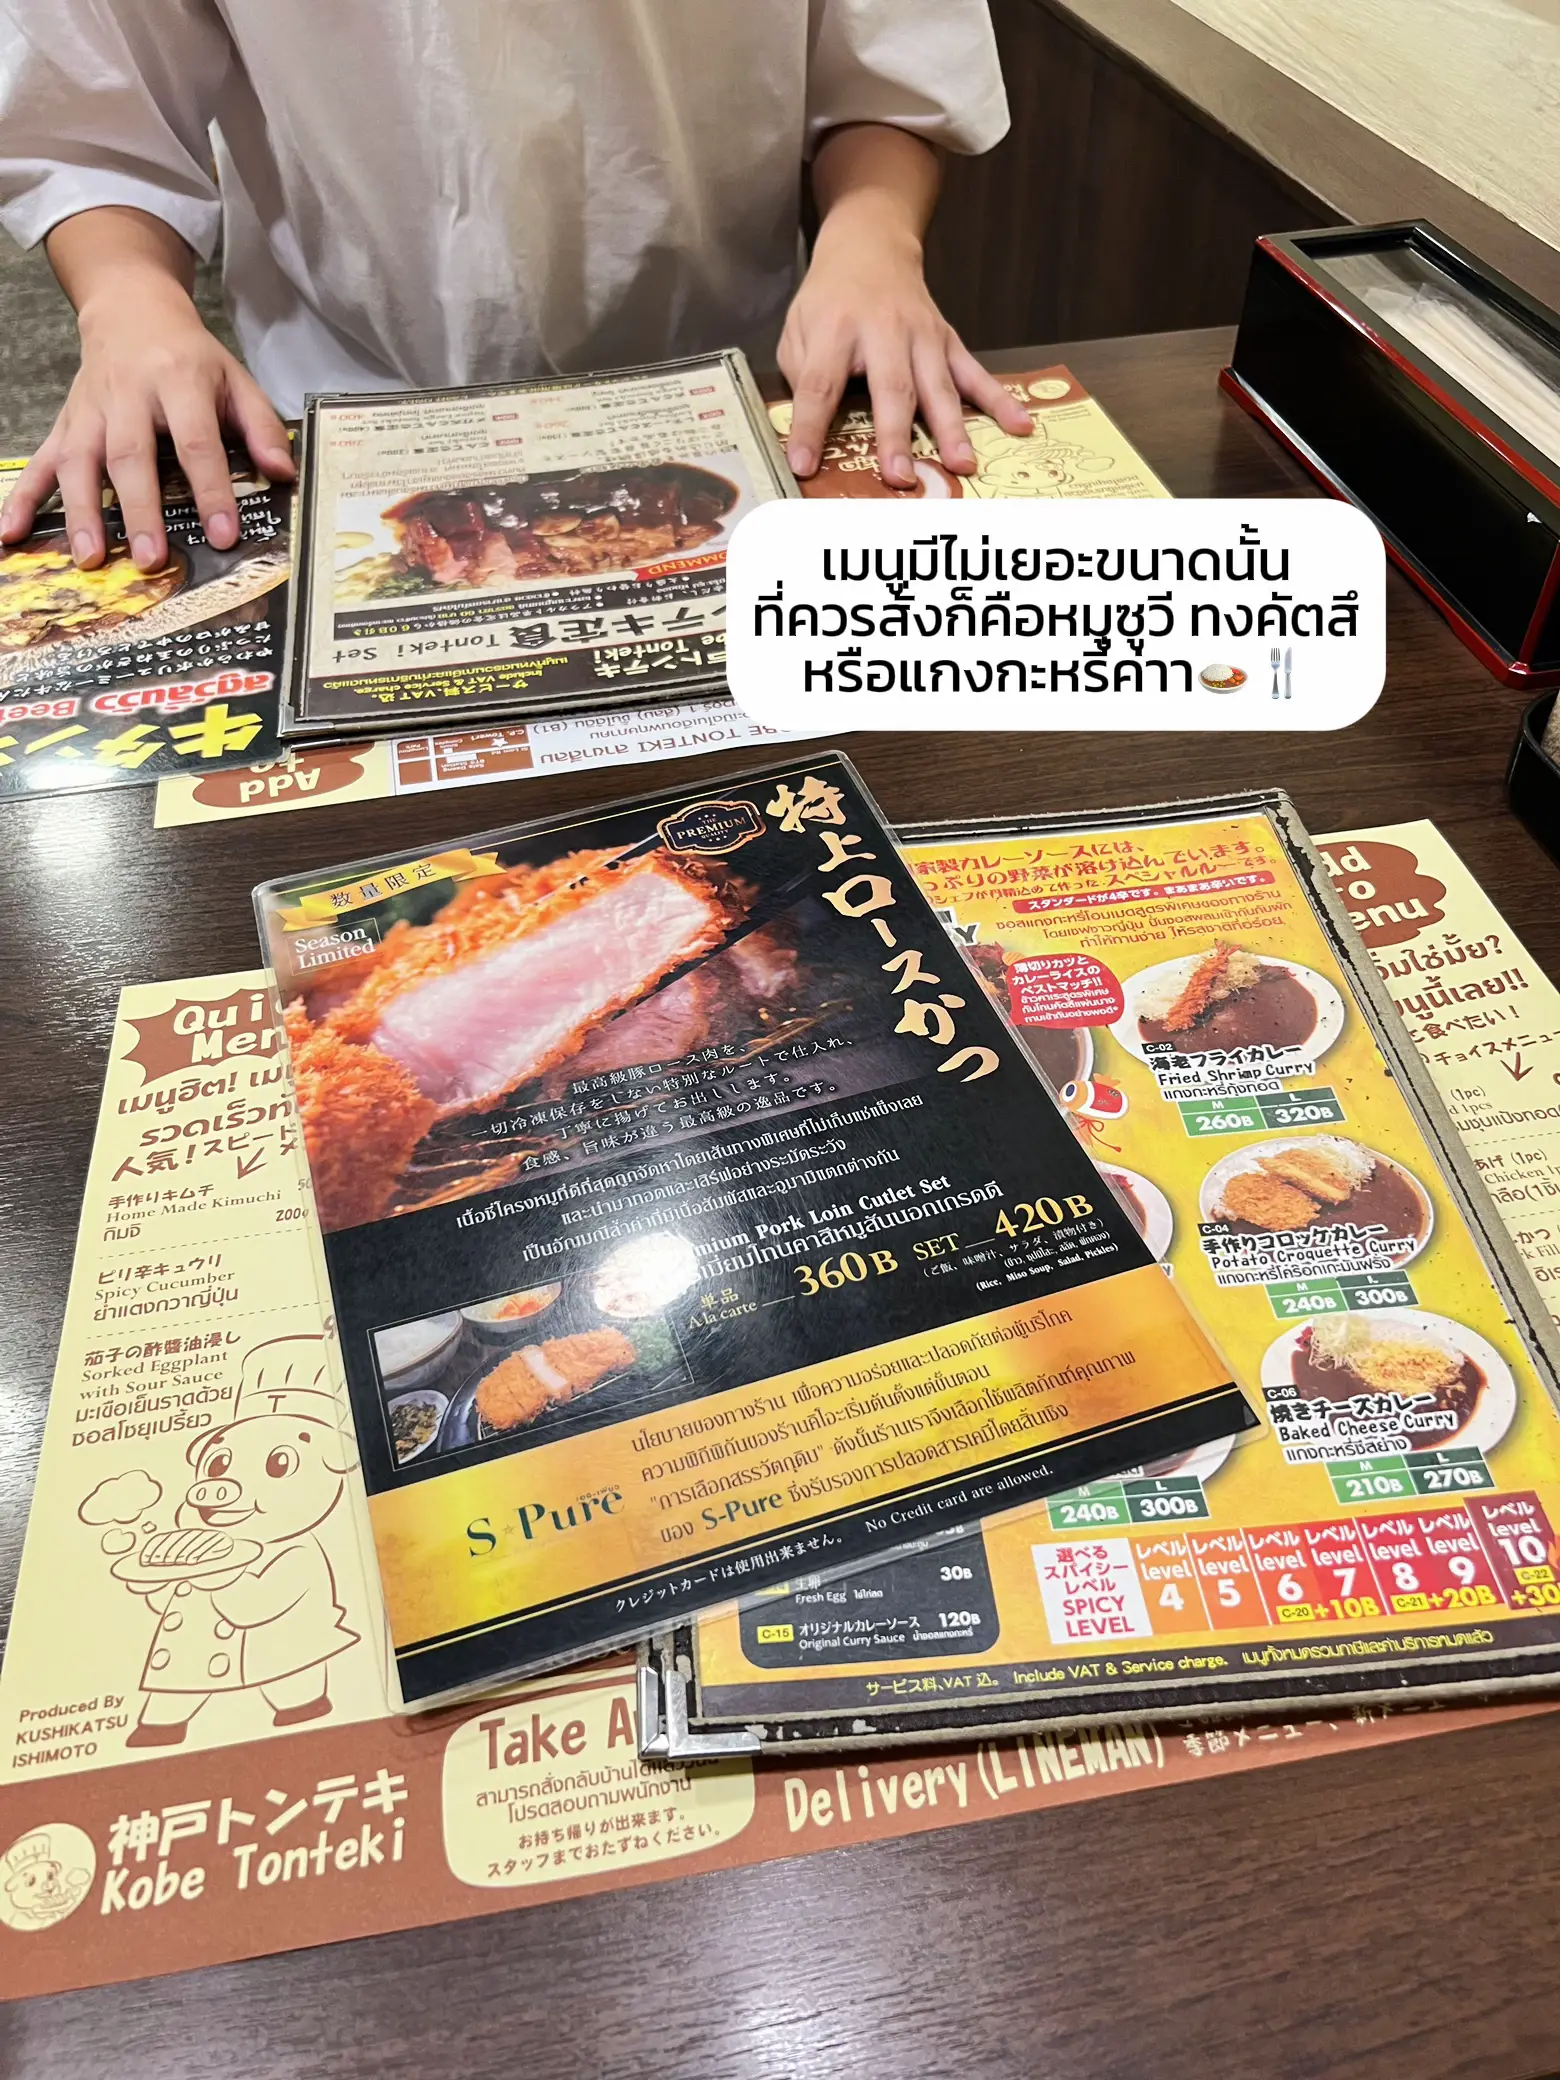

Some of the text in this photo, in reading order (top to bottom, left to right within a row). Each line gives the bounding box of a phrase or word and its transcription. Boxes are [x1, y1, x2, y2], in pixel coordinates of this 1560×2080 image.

[332, 635, 499, 663] Tonteki Set
[593, 639, 690, 663] Tonteki
[637, 728, 742, 753] TONTEKI
[240, 766, 322, 803] Add
[676, 817, 746, 840] PREMIUM
[330, 863, 436, 908] 数量限定
[295, 926, 367, 954] Season
[765, 776, 1000, 1083] 特上ロースかつ
[298, 941, 376, 970] Limited
[1011, 964, 1100, 986] カレーライスの
[1145, 1042, 1173, 1053] C-02
[1149, 1044, 1302, 1071] 海老フライカレー
[1157, 1061, 1314, 1086] Fried Shrimp Curry
[117, 1071, 238, 1115] เมนูฮิต!
[1450, 1085, 1487, 1101] (1pc)
[1195, 1106, 1334, 1132] 260B 320B
[1510, 1148, 1548, 1166] (1pc)
[1484, 1167, 1545, 1185] Chicken
[106, 1189, 282, 1223] Home Made Kimuchi
[108, 1184, 214, 1210] 手作りキムチ
[755, 1175, 951, 1240] Pork Loin Cutlet Set
[103, 1222, 142, 1242] กิมจิ
[1200, 1223, 1230, 1234] C-04
[1202, 1223, 1386, 1254] 手作りコロッケカレー
[912, 1232, 960, 1261] SET
[1211, 1237, 1416, 1269] Potato Croquette Curry
[97, 1253, 222, 1285] ピリ辛キュウリ
[976, 1242, 1119, 1292] (Rice, Miso Soup, Pickles)
[94, 1270, 235, 1302] Spicy Cucumber
[1282, 1285, 1409, 1312] 240B 300B
[93, 1286, 239, 1322] ยำแตงกวาญี่ปุ่น
[720, 1300, 758, 1321] carte
[81, 1351, 229, 1383] Sorked Eggplant
[80, 1371, 223, 1400] with Sour Sauce
[1266, 1387, 1297, 1398] C-06
[631, 1393, 788, 1453] นโยบายของทางร้าน
[1279, 1412, 1455, 1442] Baked Cheese Curry
[1347, 1469, 1484, 1497] 210B 270B
[660, 1520, 695, 1544] ของ
[701, 1491, 784, 1531] S-Pure
[1059, 1497, 1199, 1523] 240B 300B
[1480, 1498, 1536, 1519] レベル
[1304, 1523, 1357, 1544] レベル
[1363, 1519, 1414, 1540] レベル
[1418, 1512, 1471, 1534] レベル
[1487, 1516, 1542, 1538] level
[616, 1463, 1054, 1613] クレジットカードは使用出来ません。 No Credit card are allowed.
[1136, 1538, 1188, 1559] レベル
[1191, 1534, 1244, 1554] レベル
[1249, 1528, 1300, 1549] レベル
[1368, 1538, 1422, 1561] level
[1425, 1533, 1480, 1556] level
[1055, 1545, 1108, 1563] 選べる
[1253, 1550, 1307, 1572] level
[1310, 1544, 1365, 1567] level
[1498, 1537, 1547, 1567] 10
[939, 1565, 973, 1581] 30B
[1044, 1561, 1129, 1581] スパイシー
[1141, 1561, 1193, 1583] level
[1197, 1555, 1250, 1577] level
[1391, 1564, 1419, 1593] 8
[1448, 1556, 1476, 1586] 9
[1519, 1567, 1550, 1581] C-22
[1064, 1577, 1117, 1596] レベル
[1218, 1579, 1243, 1607] 5
[1277, 1574, 1303, 1602] 6
[1332, 1568, 1359, 1597] 7
[795, 1590, 847, 1604] Fresh Egg
[1062, 1596, 1126, 1617] SPICY
[1157, 1583, 1186, 1611] 4
[1281, 1596, 1381, 1621] C-20 +10B
[1395, 1584, 1498, 1609] C-21 +20B
[761, 1611, 981, 1639] C-15 オリジナルカレーソース 120B
[1066, 1617, 1136, 1638] LEVEL
[799, 1632, 906, 1651] Original Curry Sauce
[1014, 1655, 1229, 1684] Include VAT & Service charge.
[19, 1694, 125, 1723] Produced By
[15, 1714, 129, 1746] KUSHIKATSU
[479, 1713, 587, 1771] Take
[12, 1741, 98, 1769] ISHIMOTO
[507, 1776, 692, 1824] โปรดสอบถามพนักงาน
[784, 1758, 969, 1834] Delivery
[107, 1768, 409, 1867] 神戸トンテキ
[518, 1806, 686, 1850] お持ち帰りが出来ます。
[487, 1823, 721, 1879] スタッフまでおたずねください。
[101, 1816, 406, 1916] Kobe Tonteki
